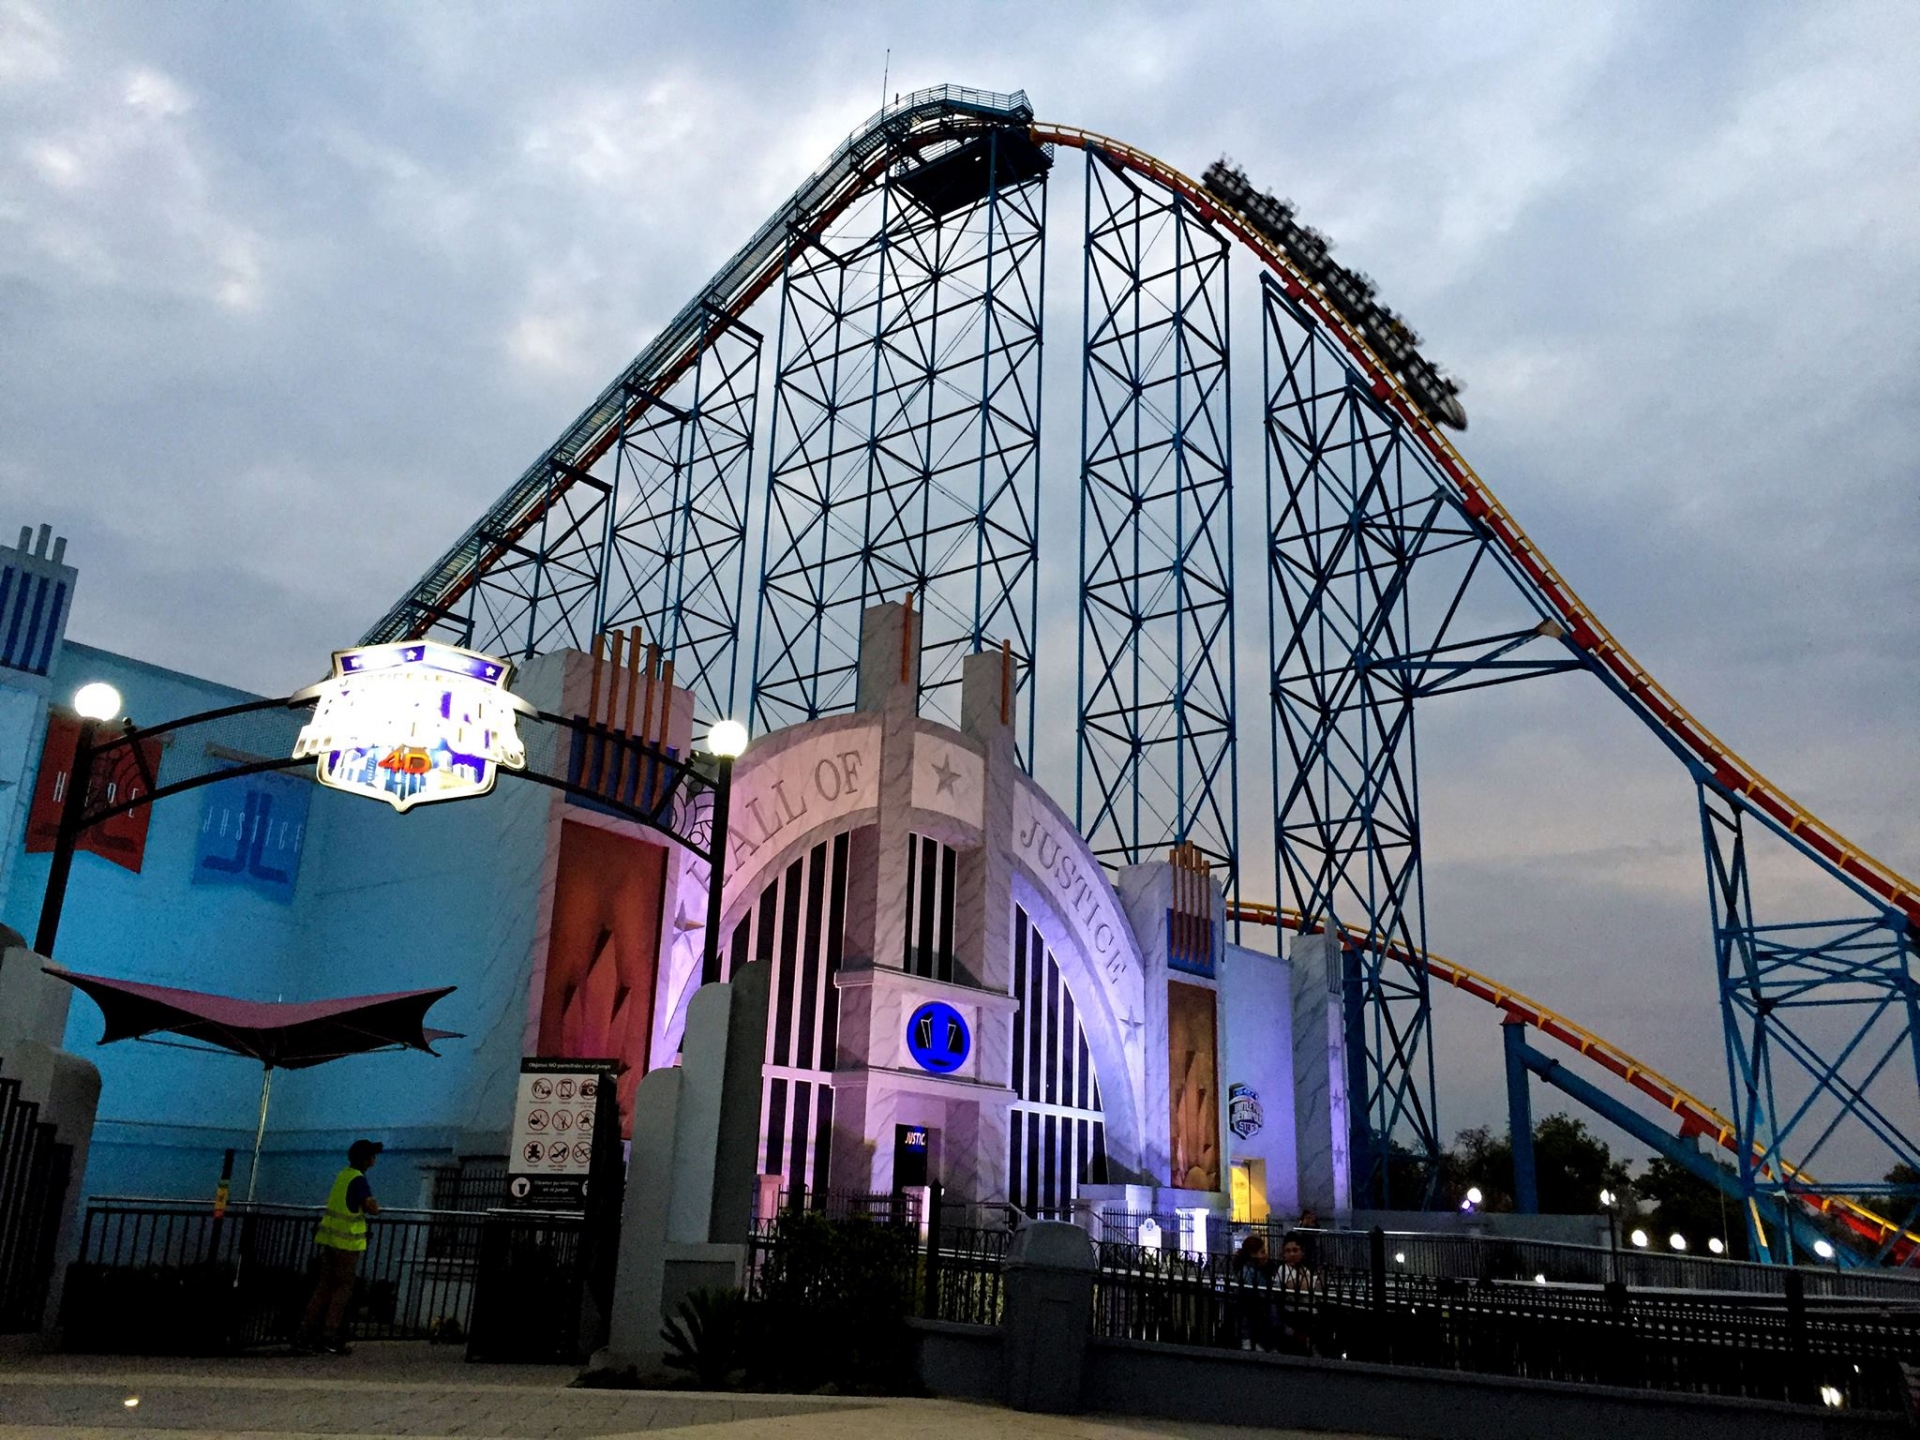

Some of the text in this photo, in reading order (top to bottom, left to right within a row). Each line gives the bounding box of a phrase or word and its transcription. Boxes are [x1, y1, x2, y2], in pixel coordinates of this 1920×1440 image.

[378, 746, 433, 775] 4D
[814, 750, 863, 802] OF
[53, 771, 139, 818] HPE
[203, 806, 303, 852] JUSTICE
[1020, 816, 1127, 985] JUSTICE
[905, 1131, 926, 1146] JUSTIC
